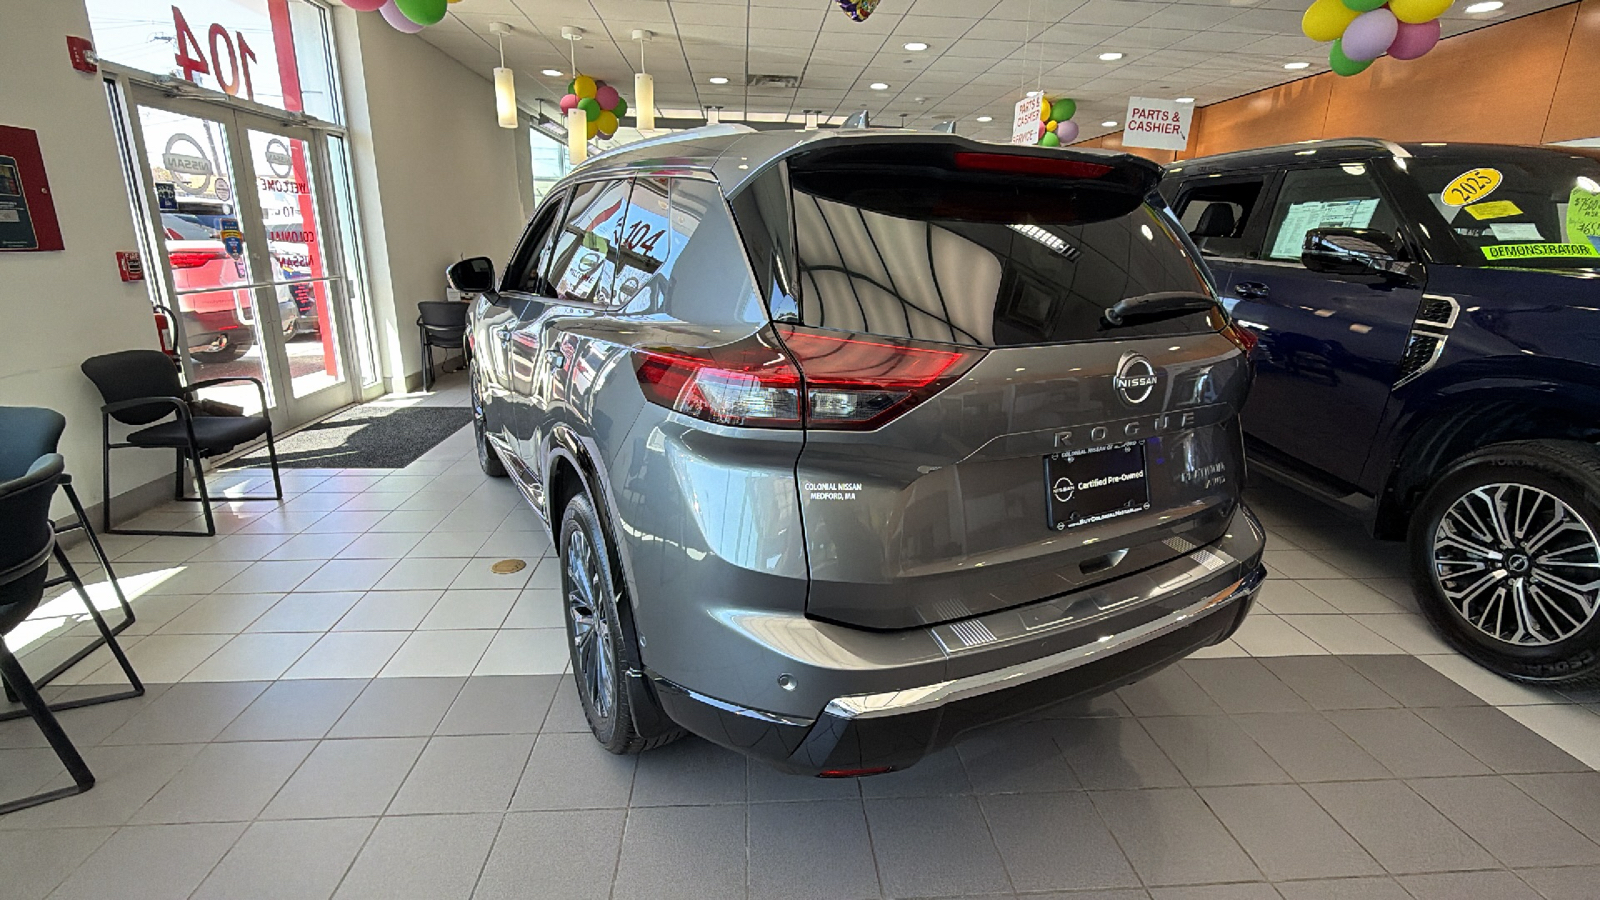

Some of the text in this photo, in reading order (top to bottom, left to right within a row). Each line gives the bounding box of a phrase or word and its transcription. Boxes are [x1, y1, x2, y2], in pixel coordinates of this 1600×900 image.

[1132, 107, 1180, 123] PARTS &
[1127, 120, 1181, 135] CASHIER
[1451, 171, 1492, 202] 2025
[1489, 244, 1591, 258] DEMONSTRATOR
[1117, 376, 1157, 388] NISSAN
[1053, 411, 1196, 448] ROGUE
[804, 483, 862, 491] COLONIAL NISSAN
[1078, 470, 1144, 491] Certified Pre-Owned
[810, 493, 844, 501] MEDFORD,
